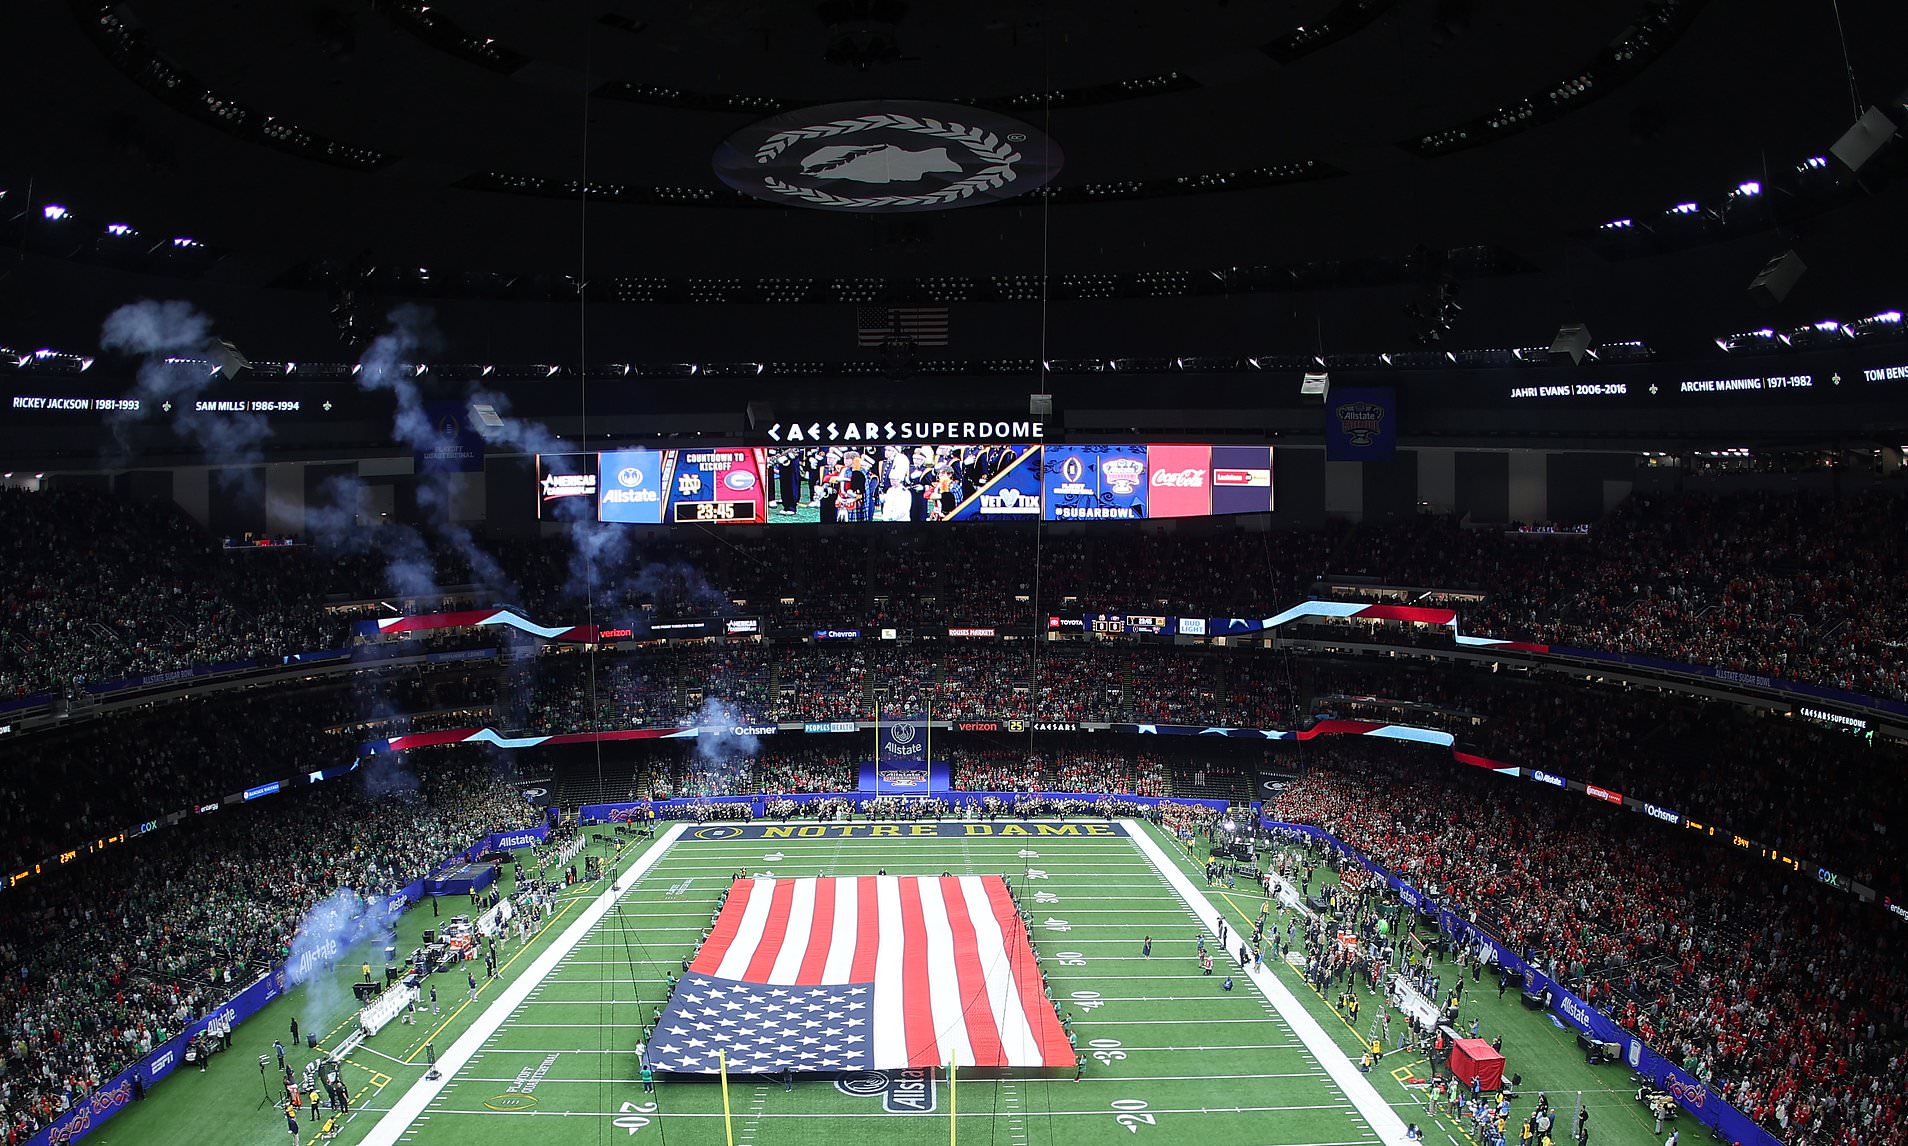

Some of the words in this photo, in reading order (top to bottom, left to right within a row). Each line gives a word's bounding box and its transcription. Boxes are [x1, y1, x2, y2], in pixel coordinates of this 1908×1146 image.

[1863, 369, 1885, 382] TOM
[1510, 386, 1538, 398] JAHRI
[1539, 385, 1570, 397] EVANS
[1576, 383, 1627, 396] 2006-2016
[1680, 380, 1715, 393] ARCHIE
[1716, 378, 1761, 391] MANNING
[1766, 375, 1813, 388] 1971-1982
[13, 397, 46, 408] RICKEY
[47, 398, 89, 410] JACKSON
[95, 399, 140, 411] 1981-1993
[195, 401, 217, 411] SAM
[217, 401, 245, 412] MILLS
[251, 401, 300, 412] 1986-1994
[767, 421, 897, 442] CAESARS
[901, 421, 1044, 438] SUPERDOME
[686, 453, 733, 463] COUNTDOWN
[734, 452, 745, 462] TO
[700, 462, 732, 471] KICKOFF
[602, 489, 658, 503] Allstate
[980, 495, 1002, 508] VET
[697, 503, 735, 520] 23:45
[600, 629, 631, 638] verizon
[828, 630, 857, 638] Chevron
[1181, 626, 1203, 634] LIGHT
[734, 726, 776, 736] Ochsner
[805, 724, 830, 732] PEOPLES
[958, 722, 998, 731] verizon
[1010, 721, 1023, 731] 25
[1033, 722, 1077, 731] CAESARS
[884, 741, 922, 755] Allstate
[1647, 804, 1679, 824] Ochsner
[141, 820, 158, 833] COX
[762, 824, 938, 839] NOTRE
[963, 822, 1118, 838] DAME
[498, 834, 535, 848] Allstate
[1818, 867, 1838, 886] COX
[300, 939, 337, 975] Allstate
[1055, 951, 1087, 966] 50
[1070, 990, 1105, 1009] 40
[1560, 996, 1590, 1027] Allstate
[1088, 1039, 1128, 1062] 30
[151, 1050, 174, 1075] ESPN
[612, 1101, 658, 1128] 20
[1111, 1098, 1157, 1127] 20
